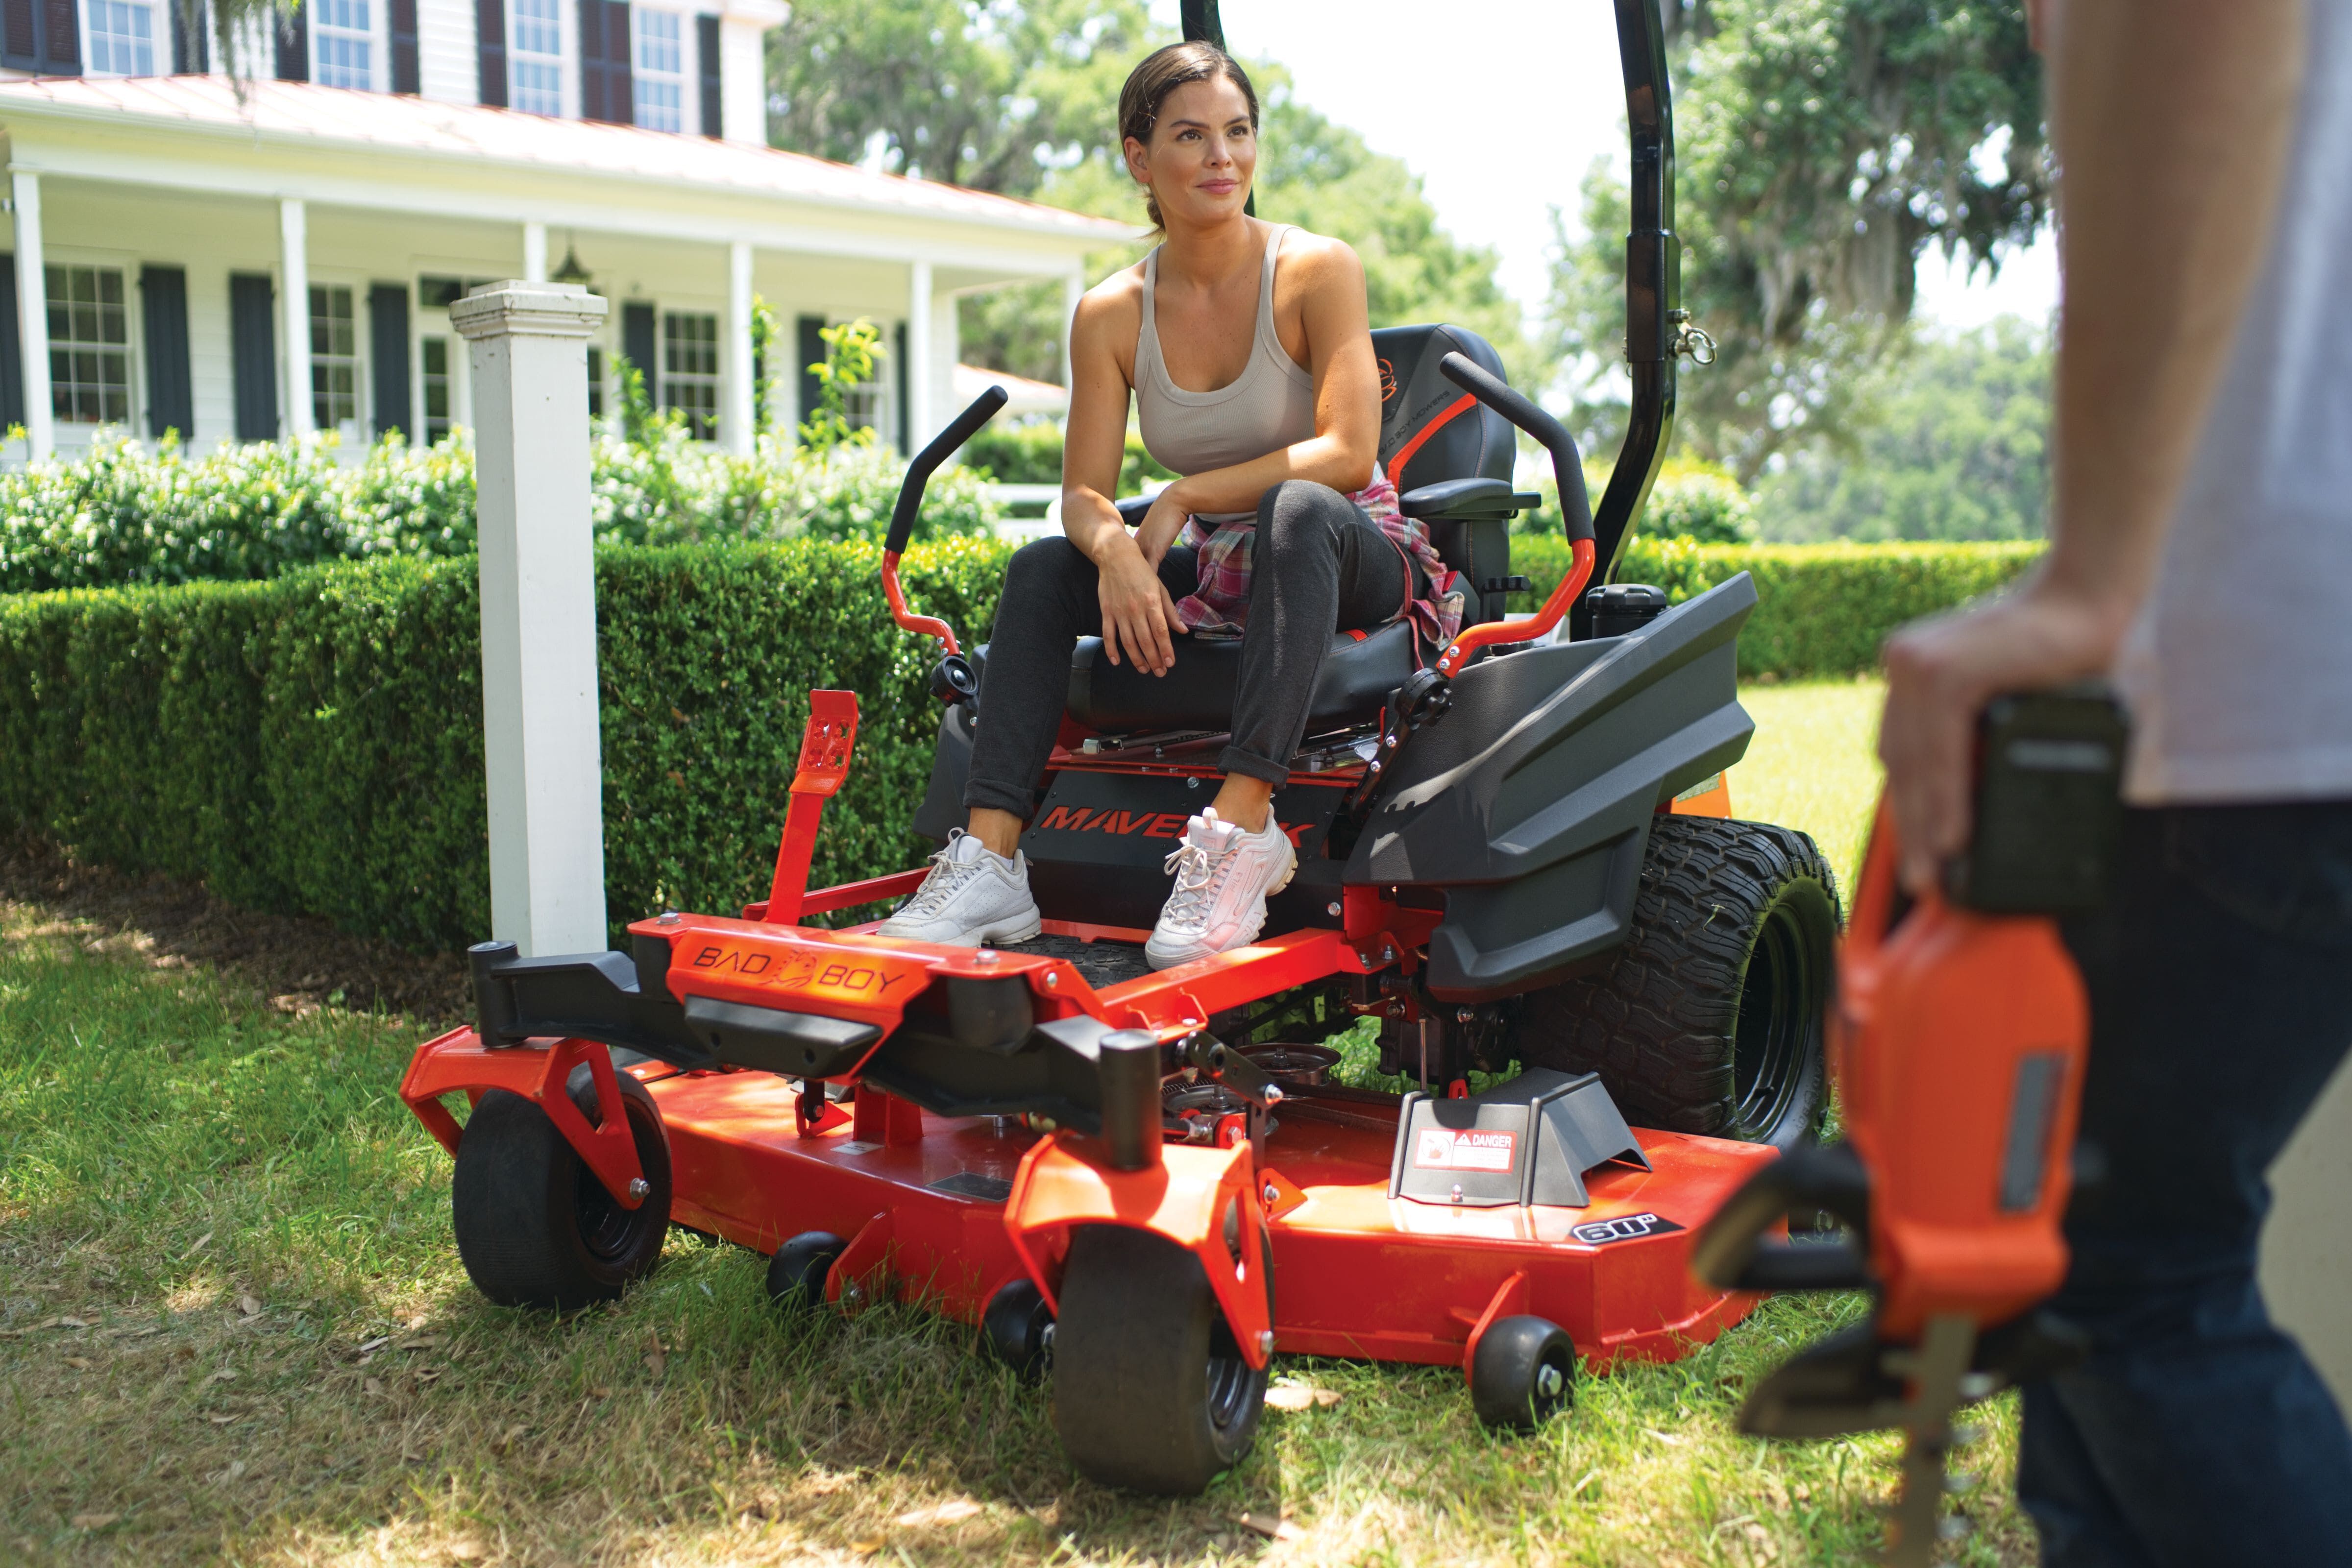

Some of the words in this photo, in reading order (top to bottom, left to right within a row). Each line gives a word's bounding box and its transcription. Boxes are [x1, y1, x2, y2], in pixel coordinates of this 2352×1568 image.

[1395, 420, 1411, 438] BOY
[1412, 390, 1450, 422] MOWERS
[1039, 805, 1317, 848] MAVEK
[1227, 872, 1243, 893] FILA
[693, 946, 771, 974] BAD
[818, 964, 905, 993] BOY
[1472, 1134, 1512, 1148] DANGER
